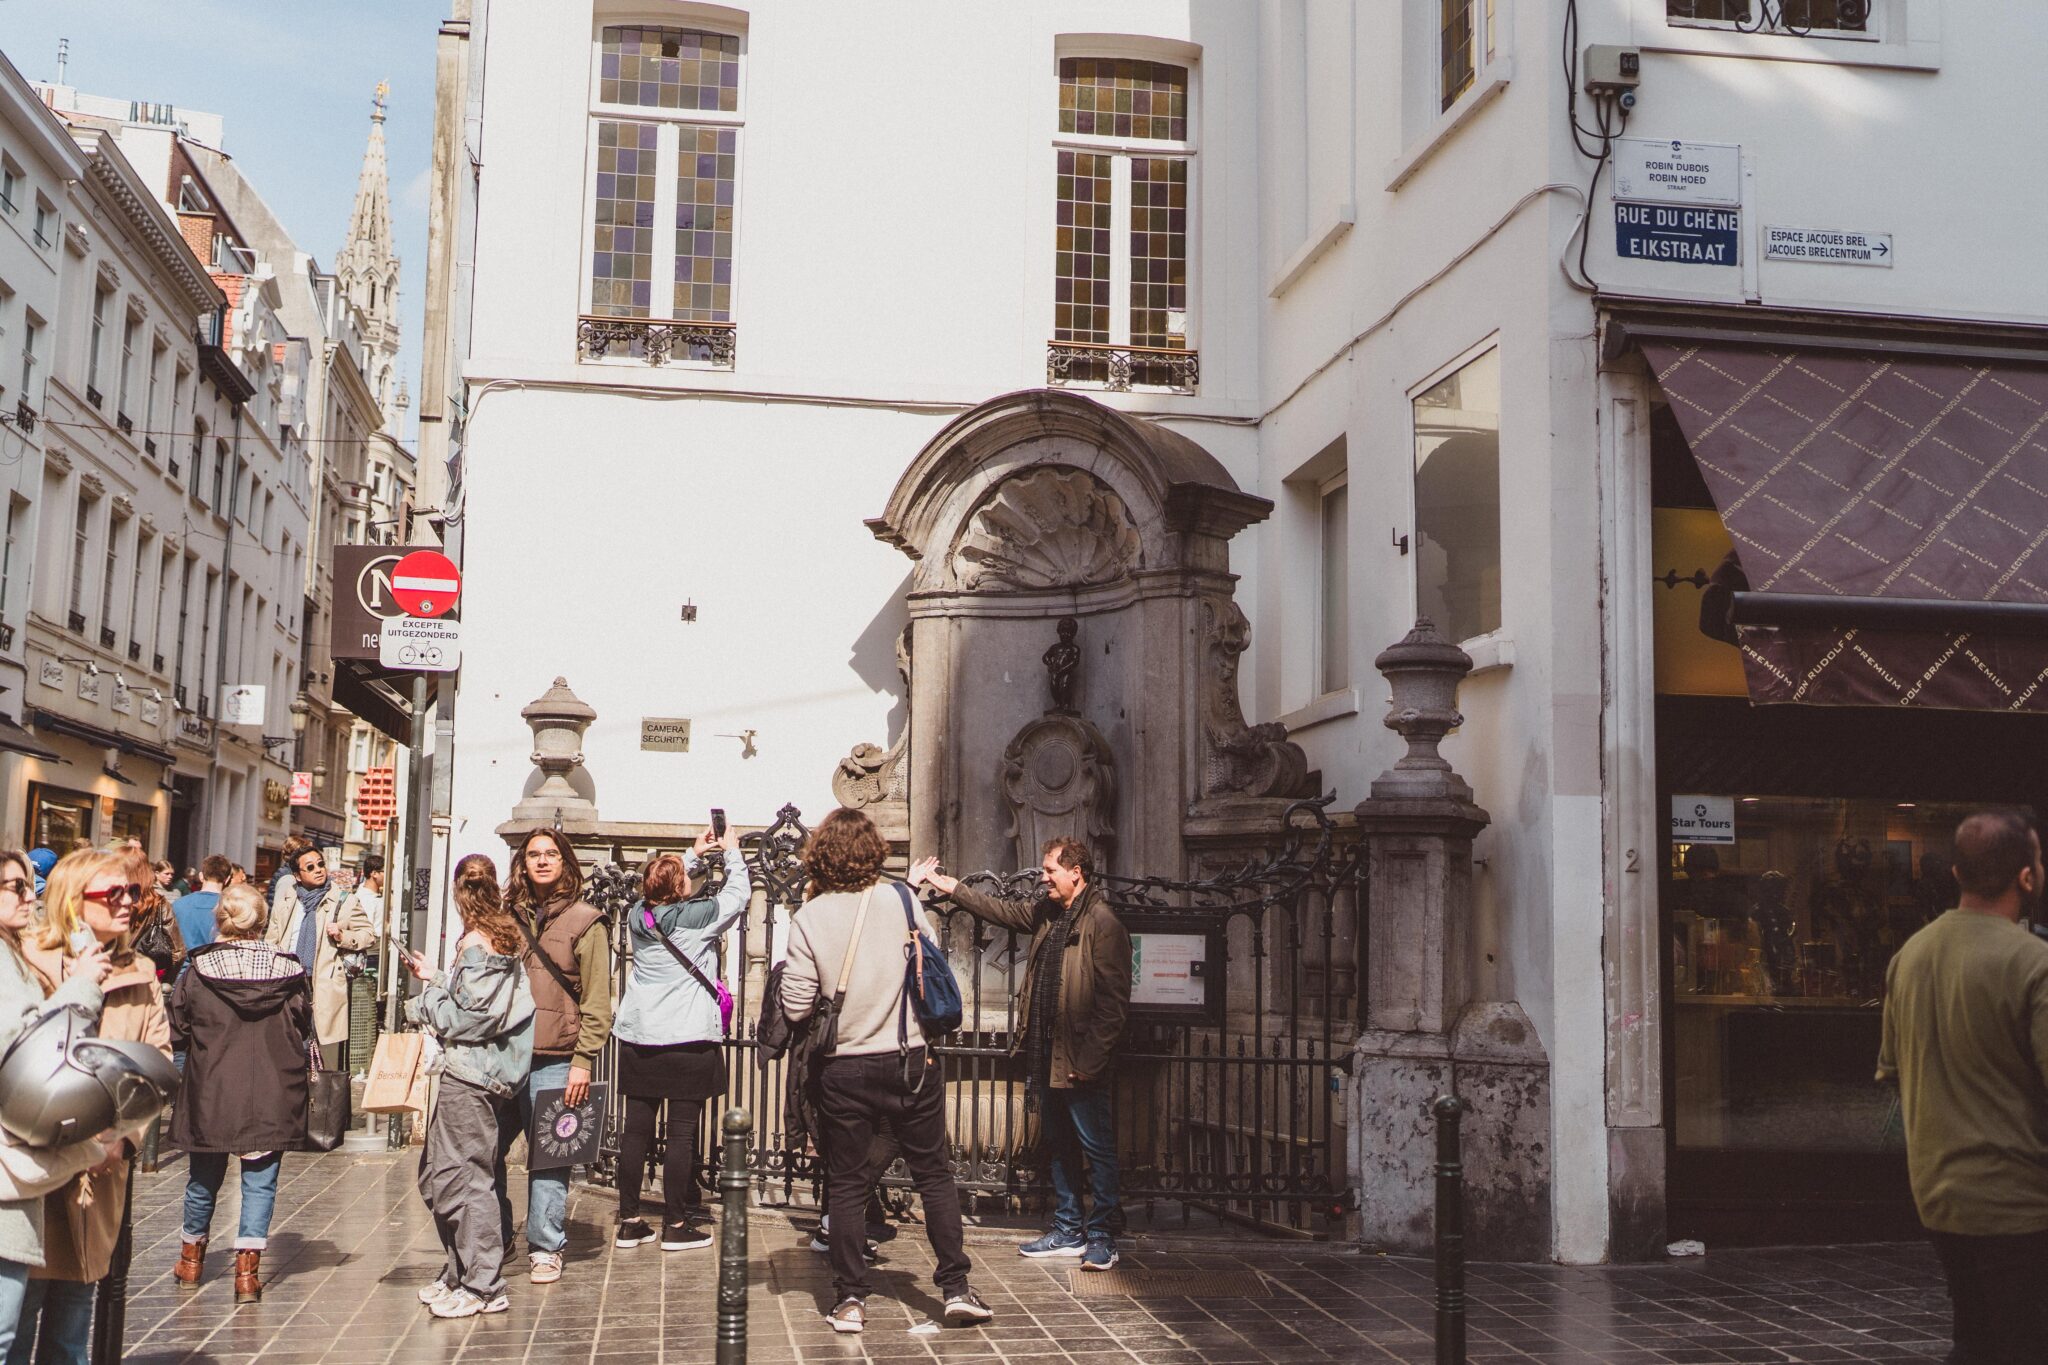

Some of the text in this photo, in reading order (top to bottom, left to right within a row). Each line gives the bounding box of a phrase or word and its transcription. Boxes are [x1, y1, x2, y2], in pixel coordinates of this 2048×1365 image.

[1645, 161, 1709, 173] ROBIN DUBOIS
[1649, 173, 1706, 184] ROBIN HOED
[1617, 206, 1738, 231] RUE DU CHÊNE
[1630, 238, 1725, 261] EIKSTRAAT
[1771, 231, 1867, 247] ESPACE JACQUES BREL
[1768, 244, 1871, 260] JACQUES BRELCENTRUM
[1698, 415, 1727, 440] PREMIUM
[1725, 383, 1763, 416] COLLECTION
[1744, 475, 1769, 498] RUDOLF
[1768, 456, 1791, 476] BRAUN
[1789, 431, 1818, 456] PREMIUM
[1815, 399, 1851, 432] COLLECTION
[1849, 378, 1873, 400] RUDOLF
[1773, 551, 1805, 578] PREMIUM
[1803, 514, 1842, 550] COLLECTION
[1840, 490, 1865, 515] RUDOLF
[1863, 472, 1885, 492] BRAUN
[1883, 447, 1910, 473] PREMIUM
[1908, 415, 1942, 448] COLLECTION
[1884, 556, 1914, 585] PREMIUM
[1911, 520, 1948, 557] COLLECTION
[1945, 497, 1969, 520] RUDOLF
[1967, 480, 1988, 499] BRAUN
[1985, 454, 2010, 480] PREMIUM
[2009, 422, 2040, 455] COLLECTION
[1998, 548, 2033, 585] COLLECTION
[387, 629, 459, 640] UITGEZONDERD
[402, 620, 443, 630] EXCEPTE
[1742, 644, 1793, 687] PREMIUM
[1807, 640, 1846, 680] RUDOLF
[1853, 645, 1902, 690] PREMIUM
[1923, 648, 1955, 681] BRAUN
[1965, 650, 2012, 696] PREMIUM
[647, 724, 684, 733] CAMERA
[1671, 817, 1731, 828] Star Tours
[1625, 848, 1640, 873] 2
[377, 1070, 408, 1080] Bershka
